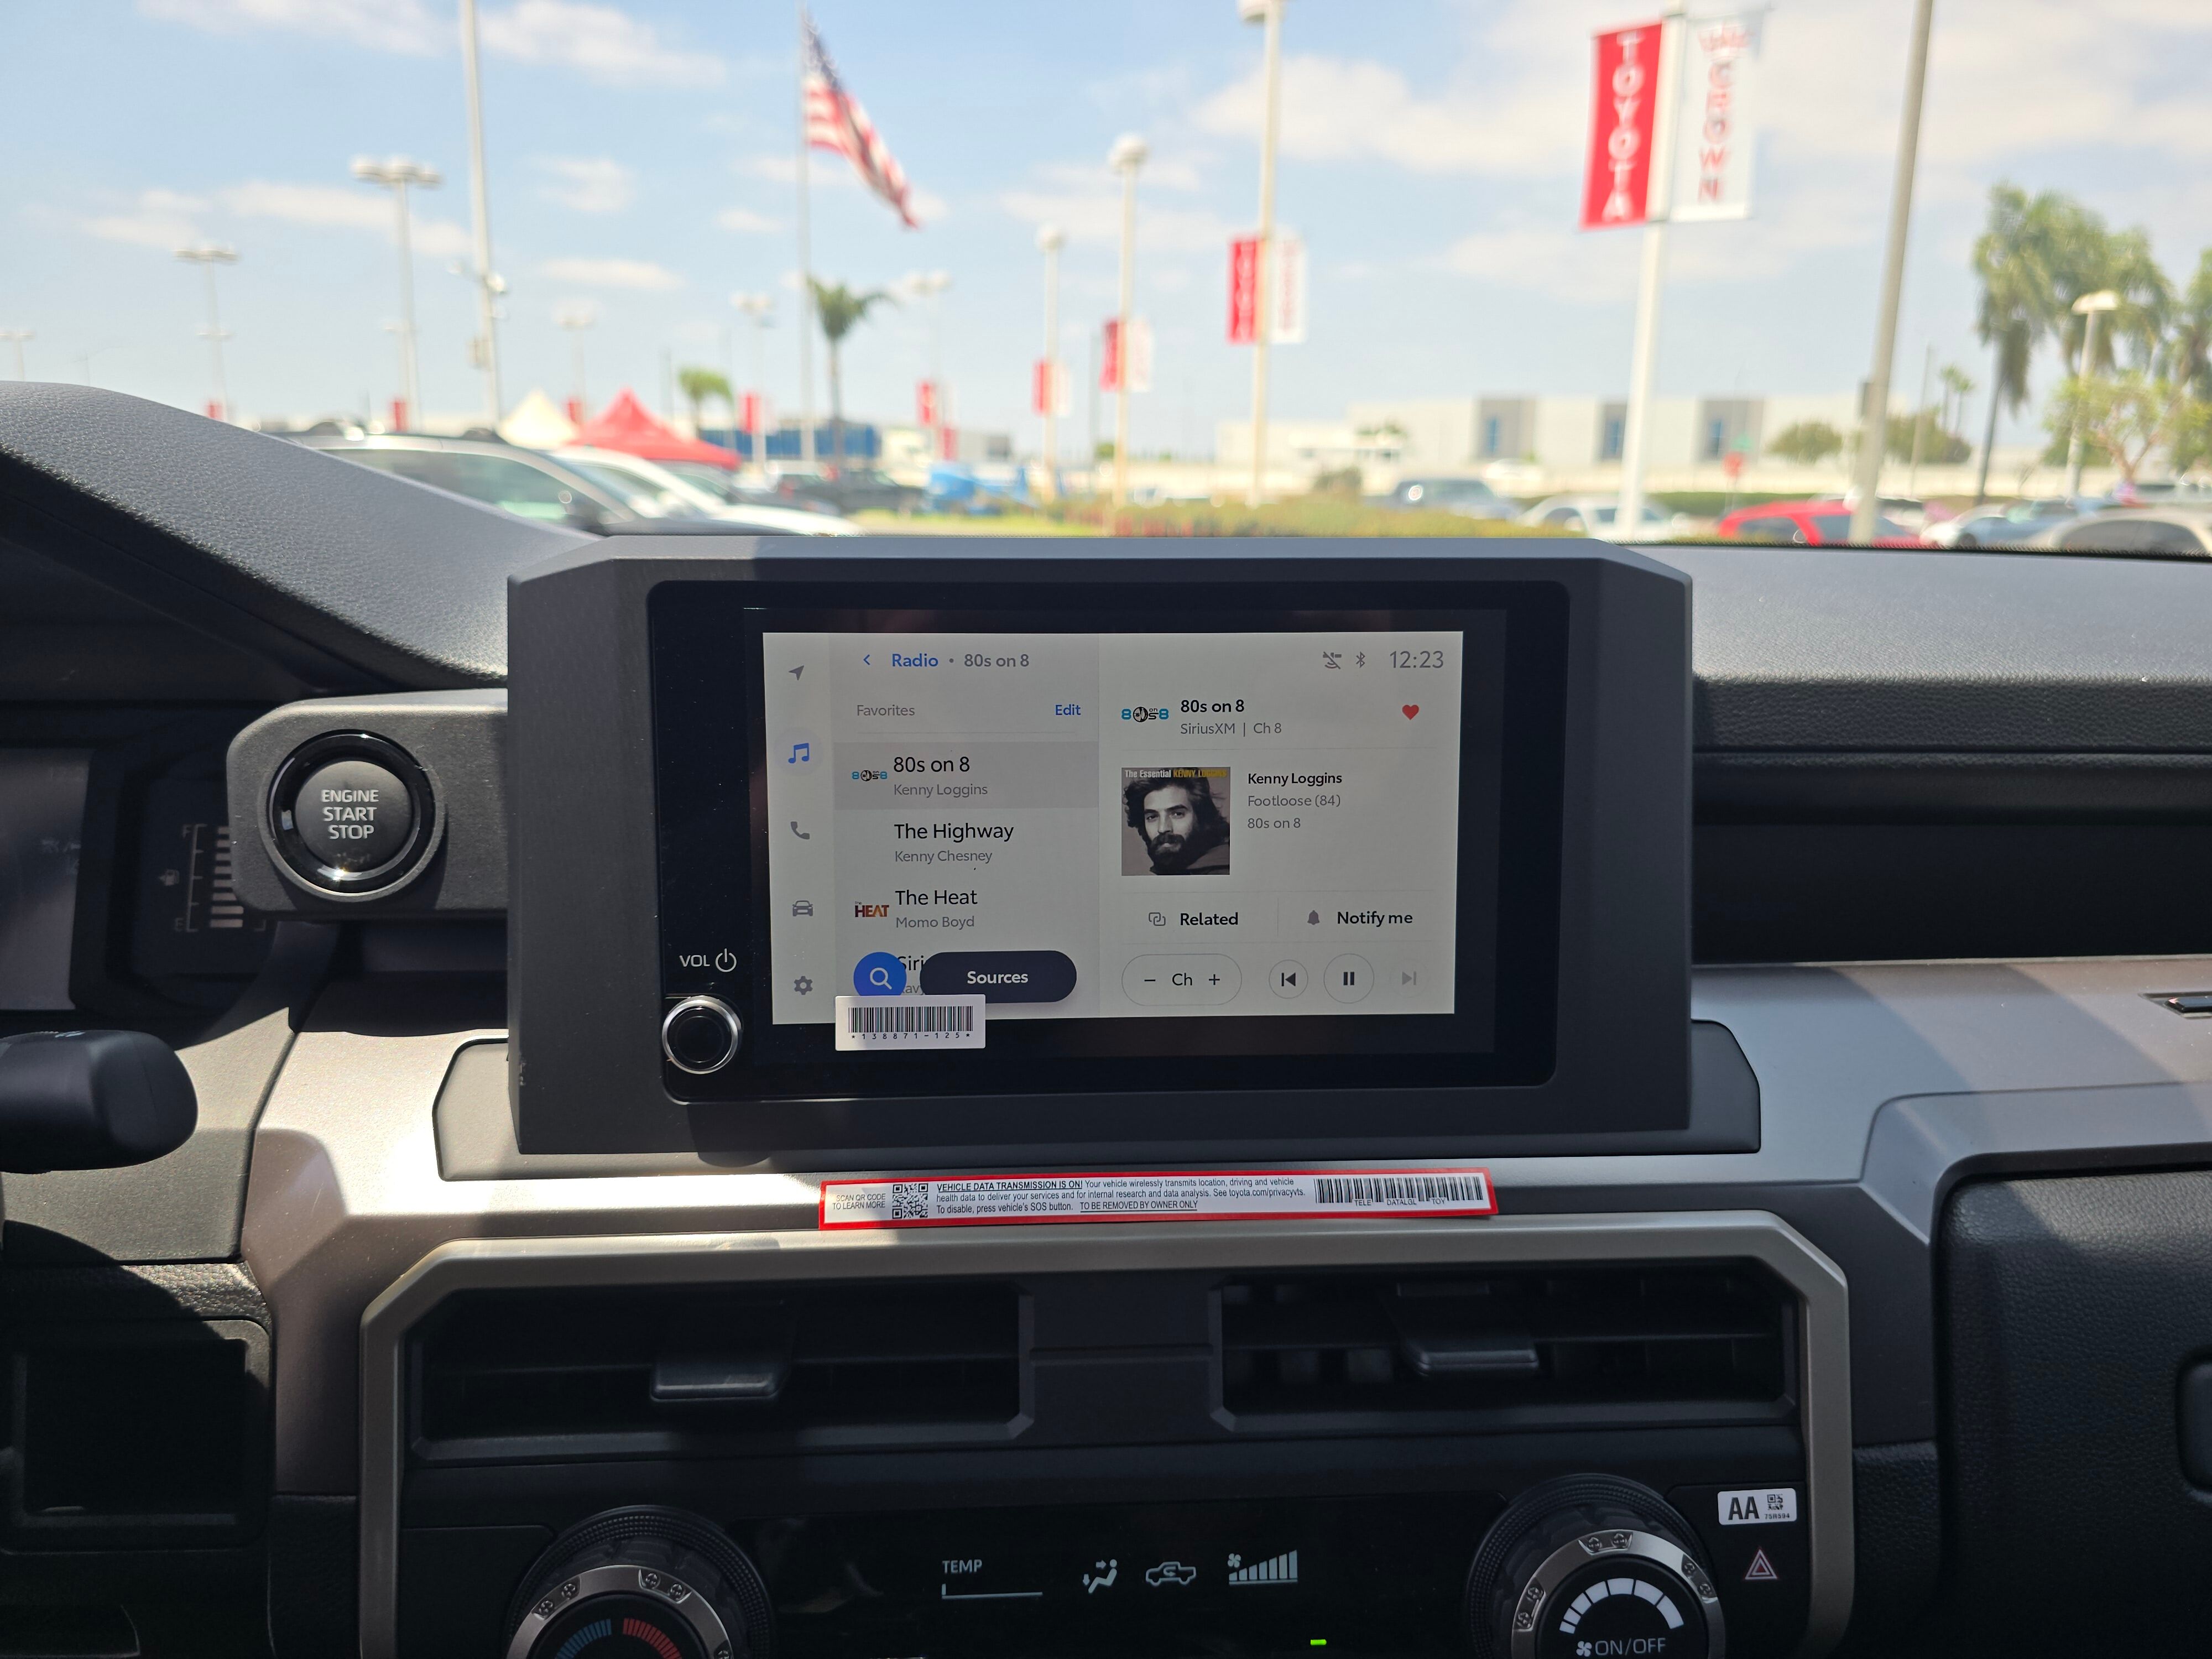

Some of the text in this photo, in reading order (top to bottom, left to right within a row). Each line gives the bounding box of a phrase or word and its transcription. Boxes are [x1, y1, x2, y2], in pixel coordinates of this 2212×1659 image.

[1601, 30, 1646, 222] TOYOTA
[1698, 61, 1735, 202] CROWN
[892, 654, 1029, 667] Radio 80s on 8
[1390, 650, 1444, 669] 12:23
[857, 705, 915, 716] Favorites
[1056, 705, 1081, 716] Edit
[1181, 699, 1245, 713] 80s on 8
[1181, 723, 1282, 734] SiriusXM Ch 8
[894, 757, 970, 773] 80s on 8
[1140, 769, 1171, 778] Essential
[1248, 772, 1342, 786] Kenny Loggins
[321, 790, 379, 802] ENGINE
[894, 784, 988, 797] Kenny Loggins
[1248, 794, 1340, 808] Footloose (84)
[322, 807, 377, 821] START
[1248, 817, 1301, 829] 80s on 8
[328, 825, 374, 839] STOP
[895, 823, 1014, 843] The Highway
[895, 850, 993, 864] Kenny Chesney
[895, 890, 978, 905] The Heat
[855, 905, 889, 917] HEAT
[896, 916, 975, 928] Momo Boyd
[1180, 912, 1238, 926] Related
[1337, 911, 1413, 927] Notify me
[679, 954, 710, 967] VOL
[967, 971, 1029, 984] Sources
[1172, 973, 1192, 987] Ch
[937, 1183, 971, 1192] VEHICLE
[973, 1182, 995, 1191] DATA
[996, 1181, 1057, 1190] TRANSMISSION
[1129, 1179, 1162, 1188] wirelessly
[1198, 1178, 1227, 1187] location,
[1230, 1178, 1252, 1187] driving
[937, 1193, 958, 1202] health
[1013, 1193, 1028, 1202] your
[1088, 1190, 1114, 1198] internal
[1181, 1189, 1211, 1198] analysis.
[1229, 1188, 1305, 1199] toyota.com/privacyvts.
[937, 1205, 945, 1214] To
[947, 1204, 974, 1214] disable,
[977, 1206, 995, 1214] press
[998, 1203, 1028, 1212] vehicle's
[1030, 1202, 1047, 1211] SOS
[1049, 1202, 1073, 1211] button.
[1080, 1202, 1089, 1210] TO
[1103, 1201, 1138, 1209] REMOVED
[1728, 1496, 1760, 1520] AA
[942, 1559, 983, 1574] TEMP
[1595, 1637, 1666, 1656] ON/OFF
